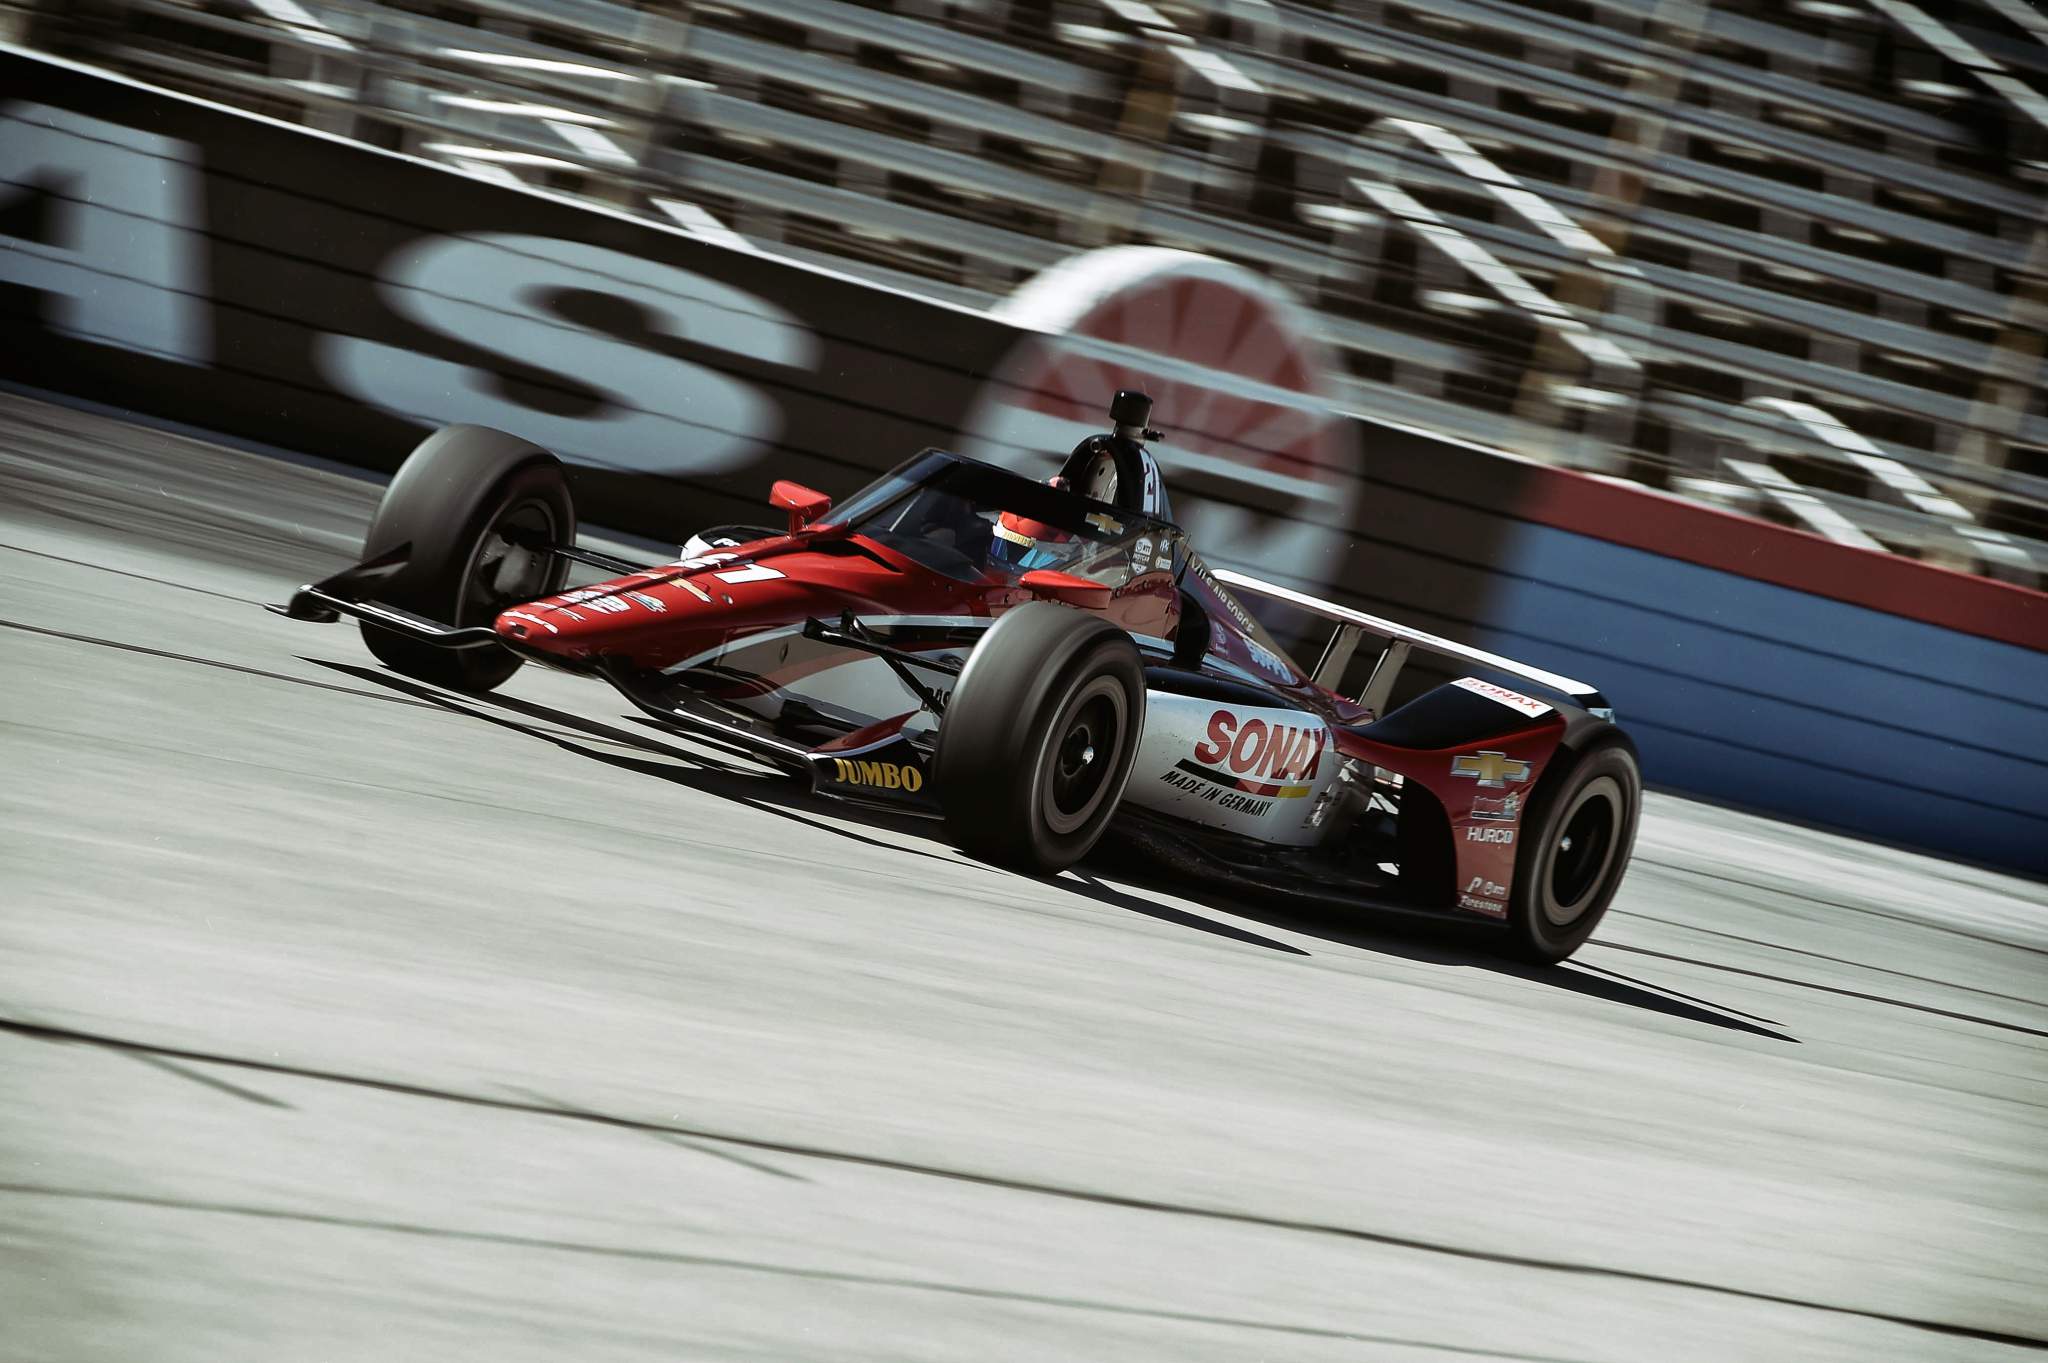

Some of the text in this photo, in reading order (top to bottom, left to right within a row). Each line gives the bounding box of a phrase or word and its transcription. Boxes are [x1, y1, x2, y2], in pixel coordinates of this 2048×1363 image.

[1194, 709, 1328, 781] SONAX
[833, 758, 923, 793] JUMBO
[1159, 770, 1274, 817] MADE IN GERMANY
[1466, 826, 1514, 844] HURCO
